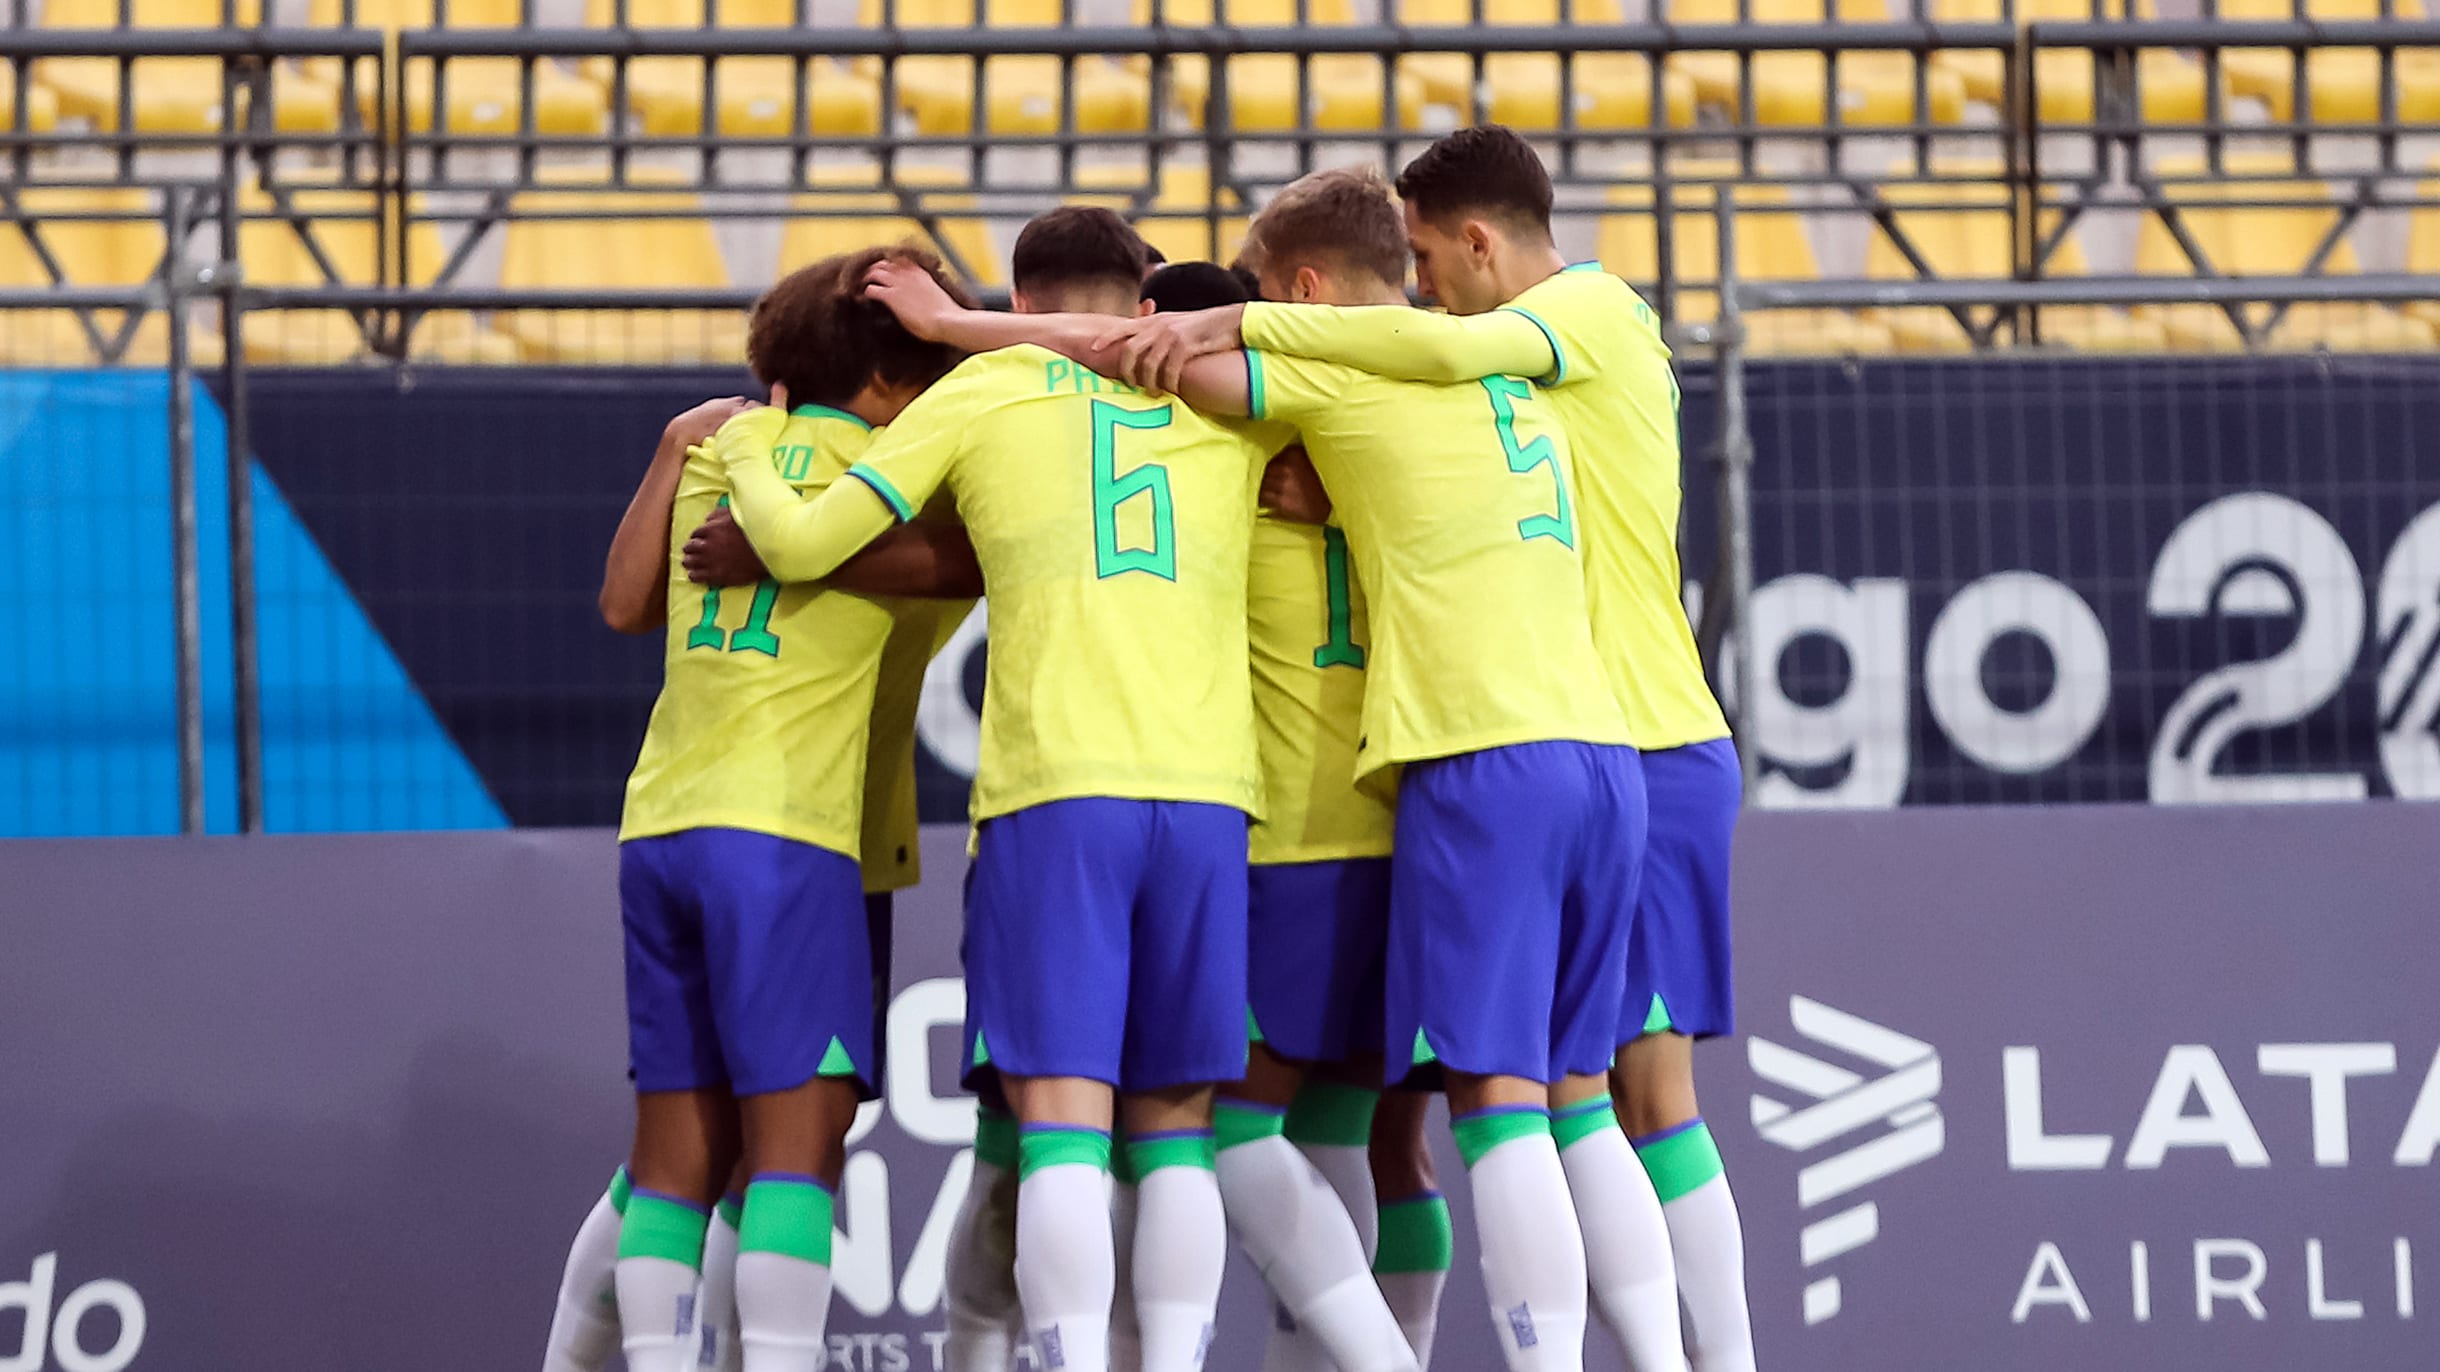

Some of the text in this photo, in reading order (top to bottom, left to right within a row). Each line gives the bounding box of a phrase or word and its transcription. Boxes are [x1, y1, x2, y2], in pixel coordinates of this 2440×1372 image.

[1091, 398, 1176, 582] 6
[1480, 374, 1574, 550] 5
[1686, 491, 2440, 810] go 2
[2011, 1237, 2415, 1323] AIRLI
